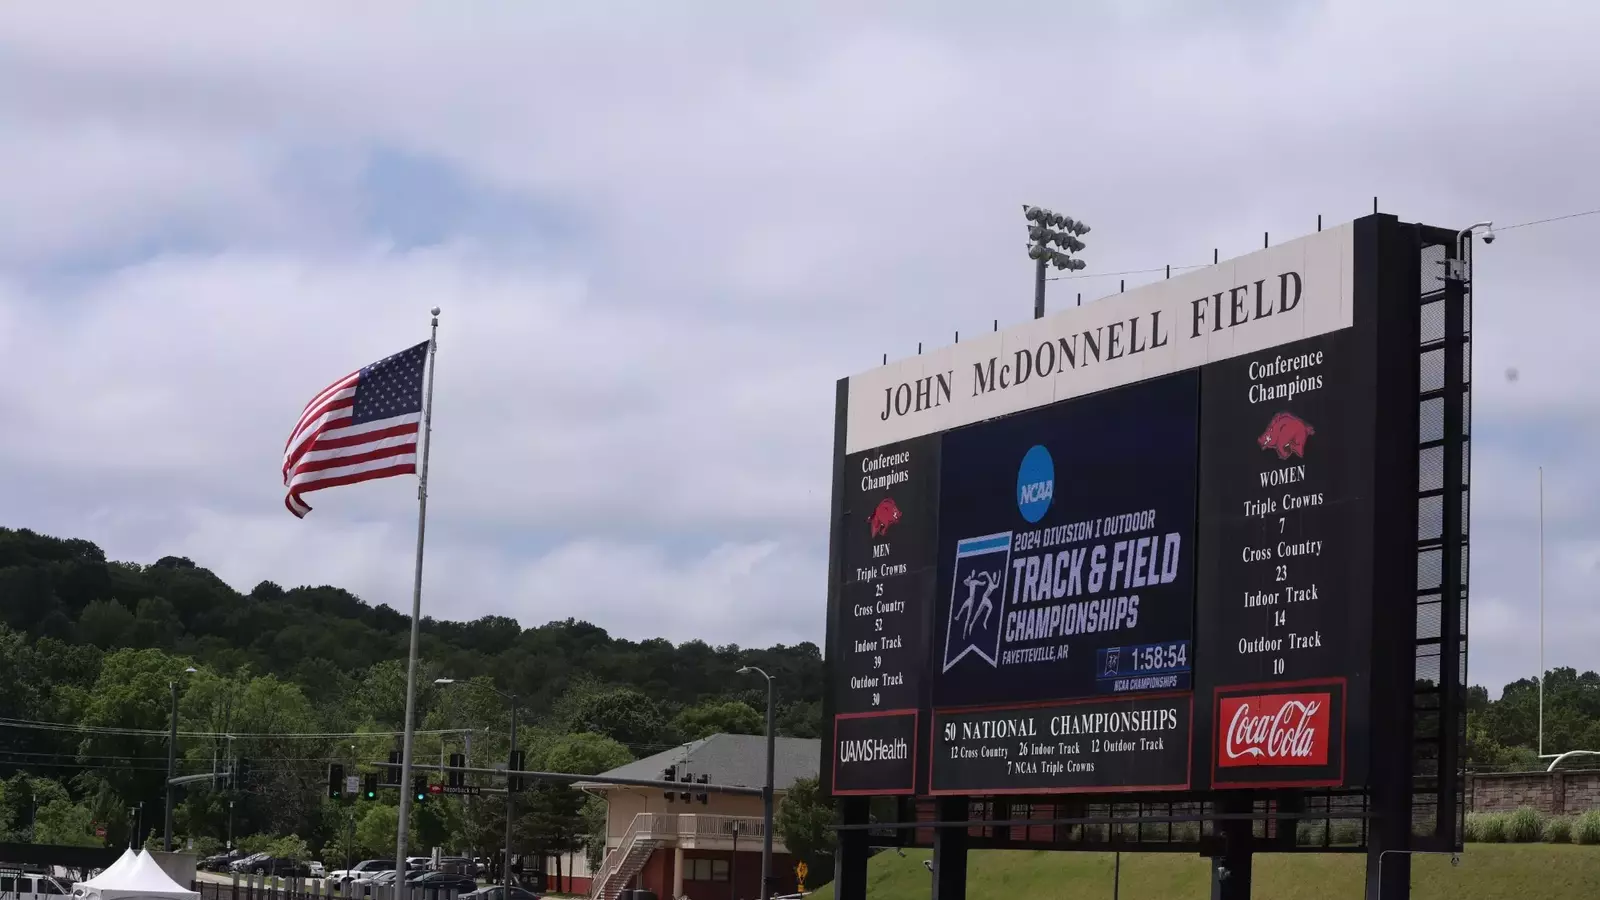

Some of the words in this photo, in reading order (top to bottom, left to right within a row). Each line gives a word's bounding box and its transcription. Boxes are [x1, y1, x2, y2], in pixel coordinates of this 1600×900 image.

[880, 370, 954, 421] JOHN
[972, 310, 1169, 398] McDONNELL
[1190, 270, 1302, 339] FIELD
[1249, 351, 1324, 380] Conference
[1248, 375, 1323, 404] Champions
[862, 451, 910, 473] Conference
[861, 469, 909, 491] Champions
[1260, 465, 1306, 488] WOMEN
[1020, 480, 1053, 505] NCAA
[1244, 498, 1277, 518] Triple
[1282, 492, 1324, 510] Crowns
[1014, 529, 1041, 551] 2024
[1043, 518, 1093, 547] DIVISION
[1094, 518, 1103, 539] I
[1103, 509, 1156, 535] OUTDOOR
[1279, 517, 1286, 533] 7
[872, 543, 891, 558] MEN
[1242, 546, 1272, 563] Cross
[1277, 539, 1322, 558] Country
[857, 565, 878, 583] Triple
[880, 563, 907, 577] Crowns
[1012, 547, 1086, 605] TRACK
[1087, 544, 1107, 594] &
[1109, 532, 1181, 591] FIELD
[1275, 565, 1287, 582] 23
[875, 583, 884, 597] 25
[1244, 590, 1280, 608] Indoor
[1286, 584, 1318, 603] Track
[854, 603, 873, 617] Cross
[876, 600, 905, 614] Country
[1005, 595, 1140, 643] CHAMPIONSHIPS
[1274, 610, 1286, 627] 14
[874, 618, 883, 631] 52
[855, 639, 877, 653] Indoor
[881, 634, 902, 650] Track
[1057, 644, 1069, 659] AR
[1238, 636, 1283, 654] Outdoor
[1288, 631, 1321, 649] Track
[873, 655, 882, 669] 39
[1131, 643, 1187, 671] 1:58:54
[1273, 658, 1285, 675] 10
[850, 675, 879, 689] Outdoor
[882, 671, 904, 686] Track
[1113, 679, 1129, 692] NCAA
[1129, 675, 1177, 690] CHAMPIONSHIPS
[871, 692, 880, 706] 30
[944, 722, 956, 741] 50
[962, 717, 1037, 740] NATIONAL
[1050, 708, 1177, 736] CHAMPIONSHIPS
[950, 746, 959, 759] 12
[960, 746, 979, 758] Cross
[981, 745, 1008, 759] Country
[1018, 741, 1028, 756] 26
[1031, 743, 1055, 755] Indoor
[1058, 742, 1080, 755] Track
[1091, 739, 1100, 753] 12
[1103, 738, 1136, 752] Outdoor
[1140, 737, 1164, 751] Track
[1007, 761, 1012, 775] 7
[1014, 761, 1037, 774] NCAA
[1041, 760, 1064, 776] Triple
[1067, 760, 1095, 773] Crowns
